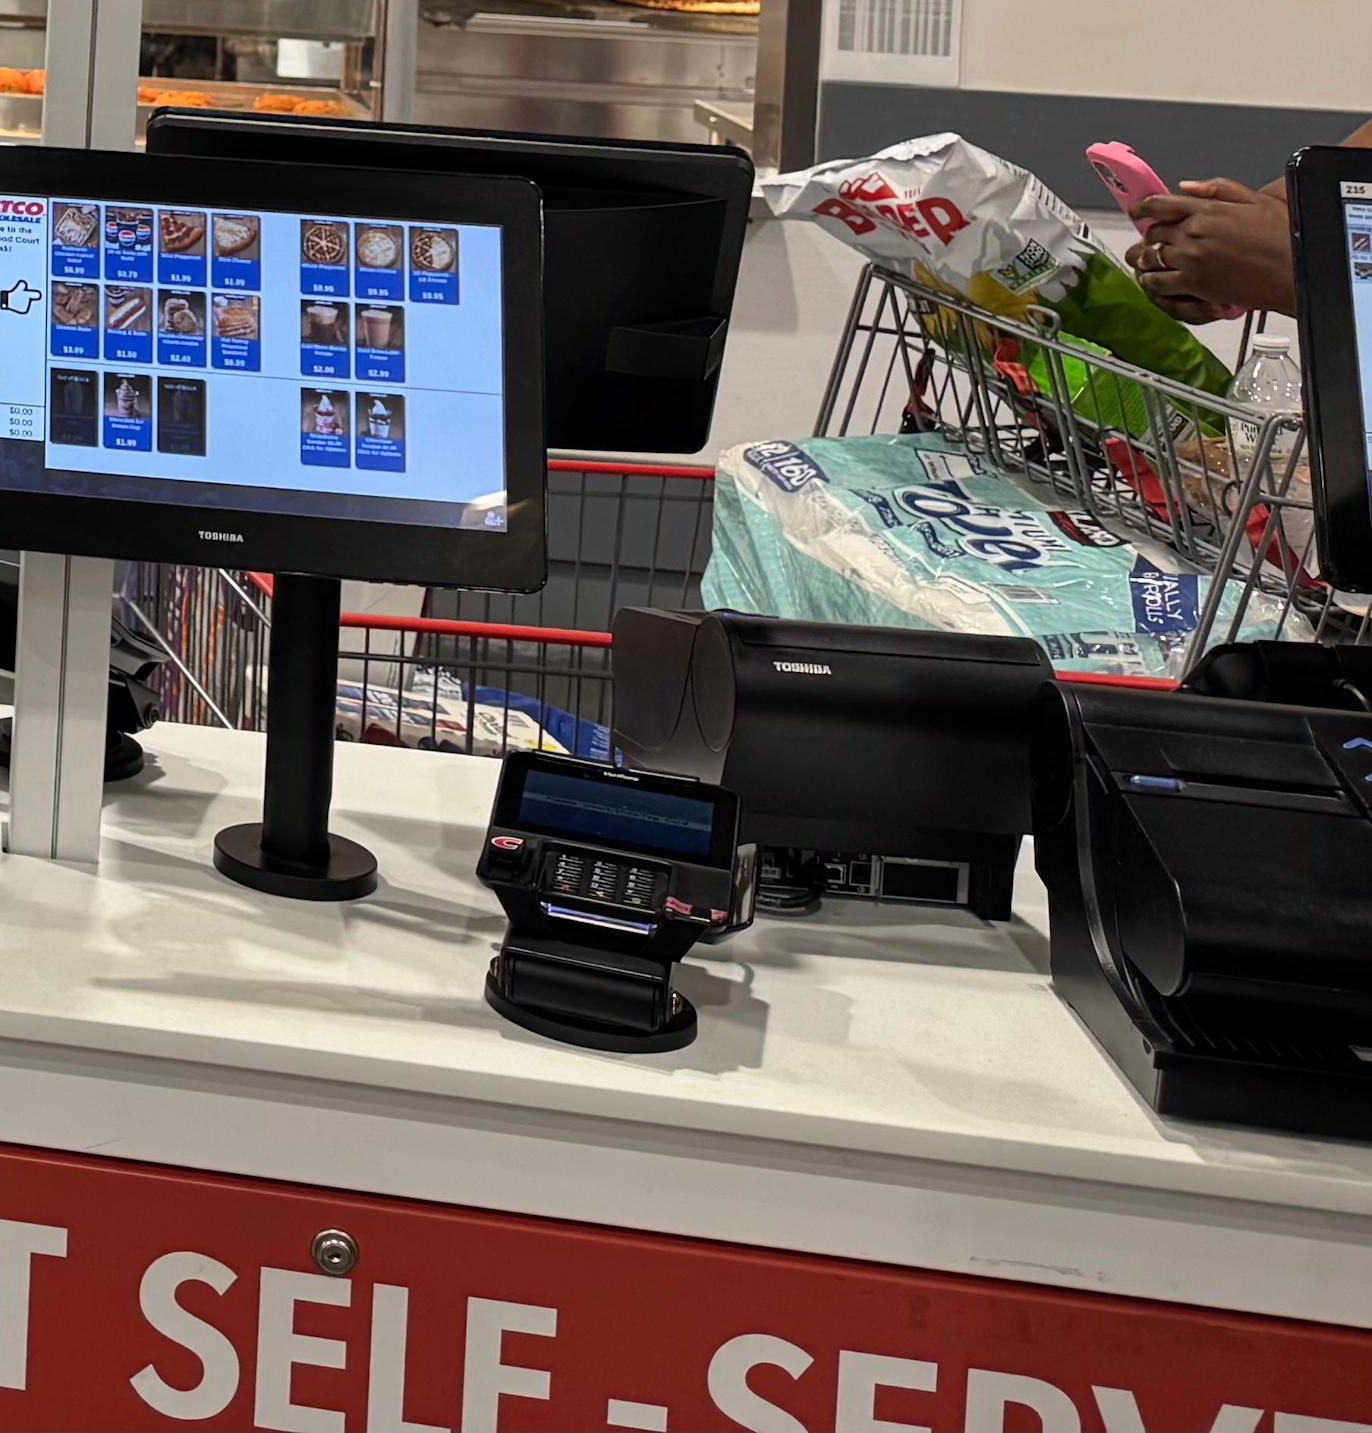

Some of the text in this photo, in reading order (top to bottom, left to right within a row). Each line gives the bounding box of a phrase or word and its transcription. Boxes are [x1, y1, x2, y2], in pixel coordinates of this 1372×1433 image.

[16, 236, 40, 245] Court
[10, 407, 33, 415] $0.00
[9, 418, 32, 426] $0.00
[9, 429, 32, 437] $0.00
[198, 530, 244, 543] TOSHIBA
[773, 661, 832, 675] TOSHIBA
[129, 1249, 559, 1433] SELF
